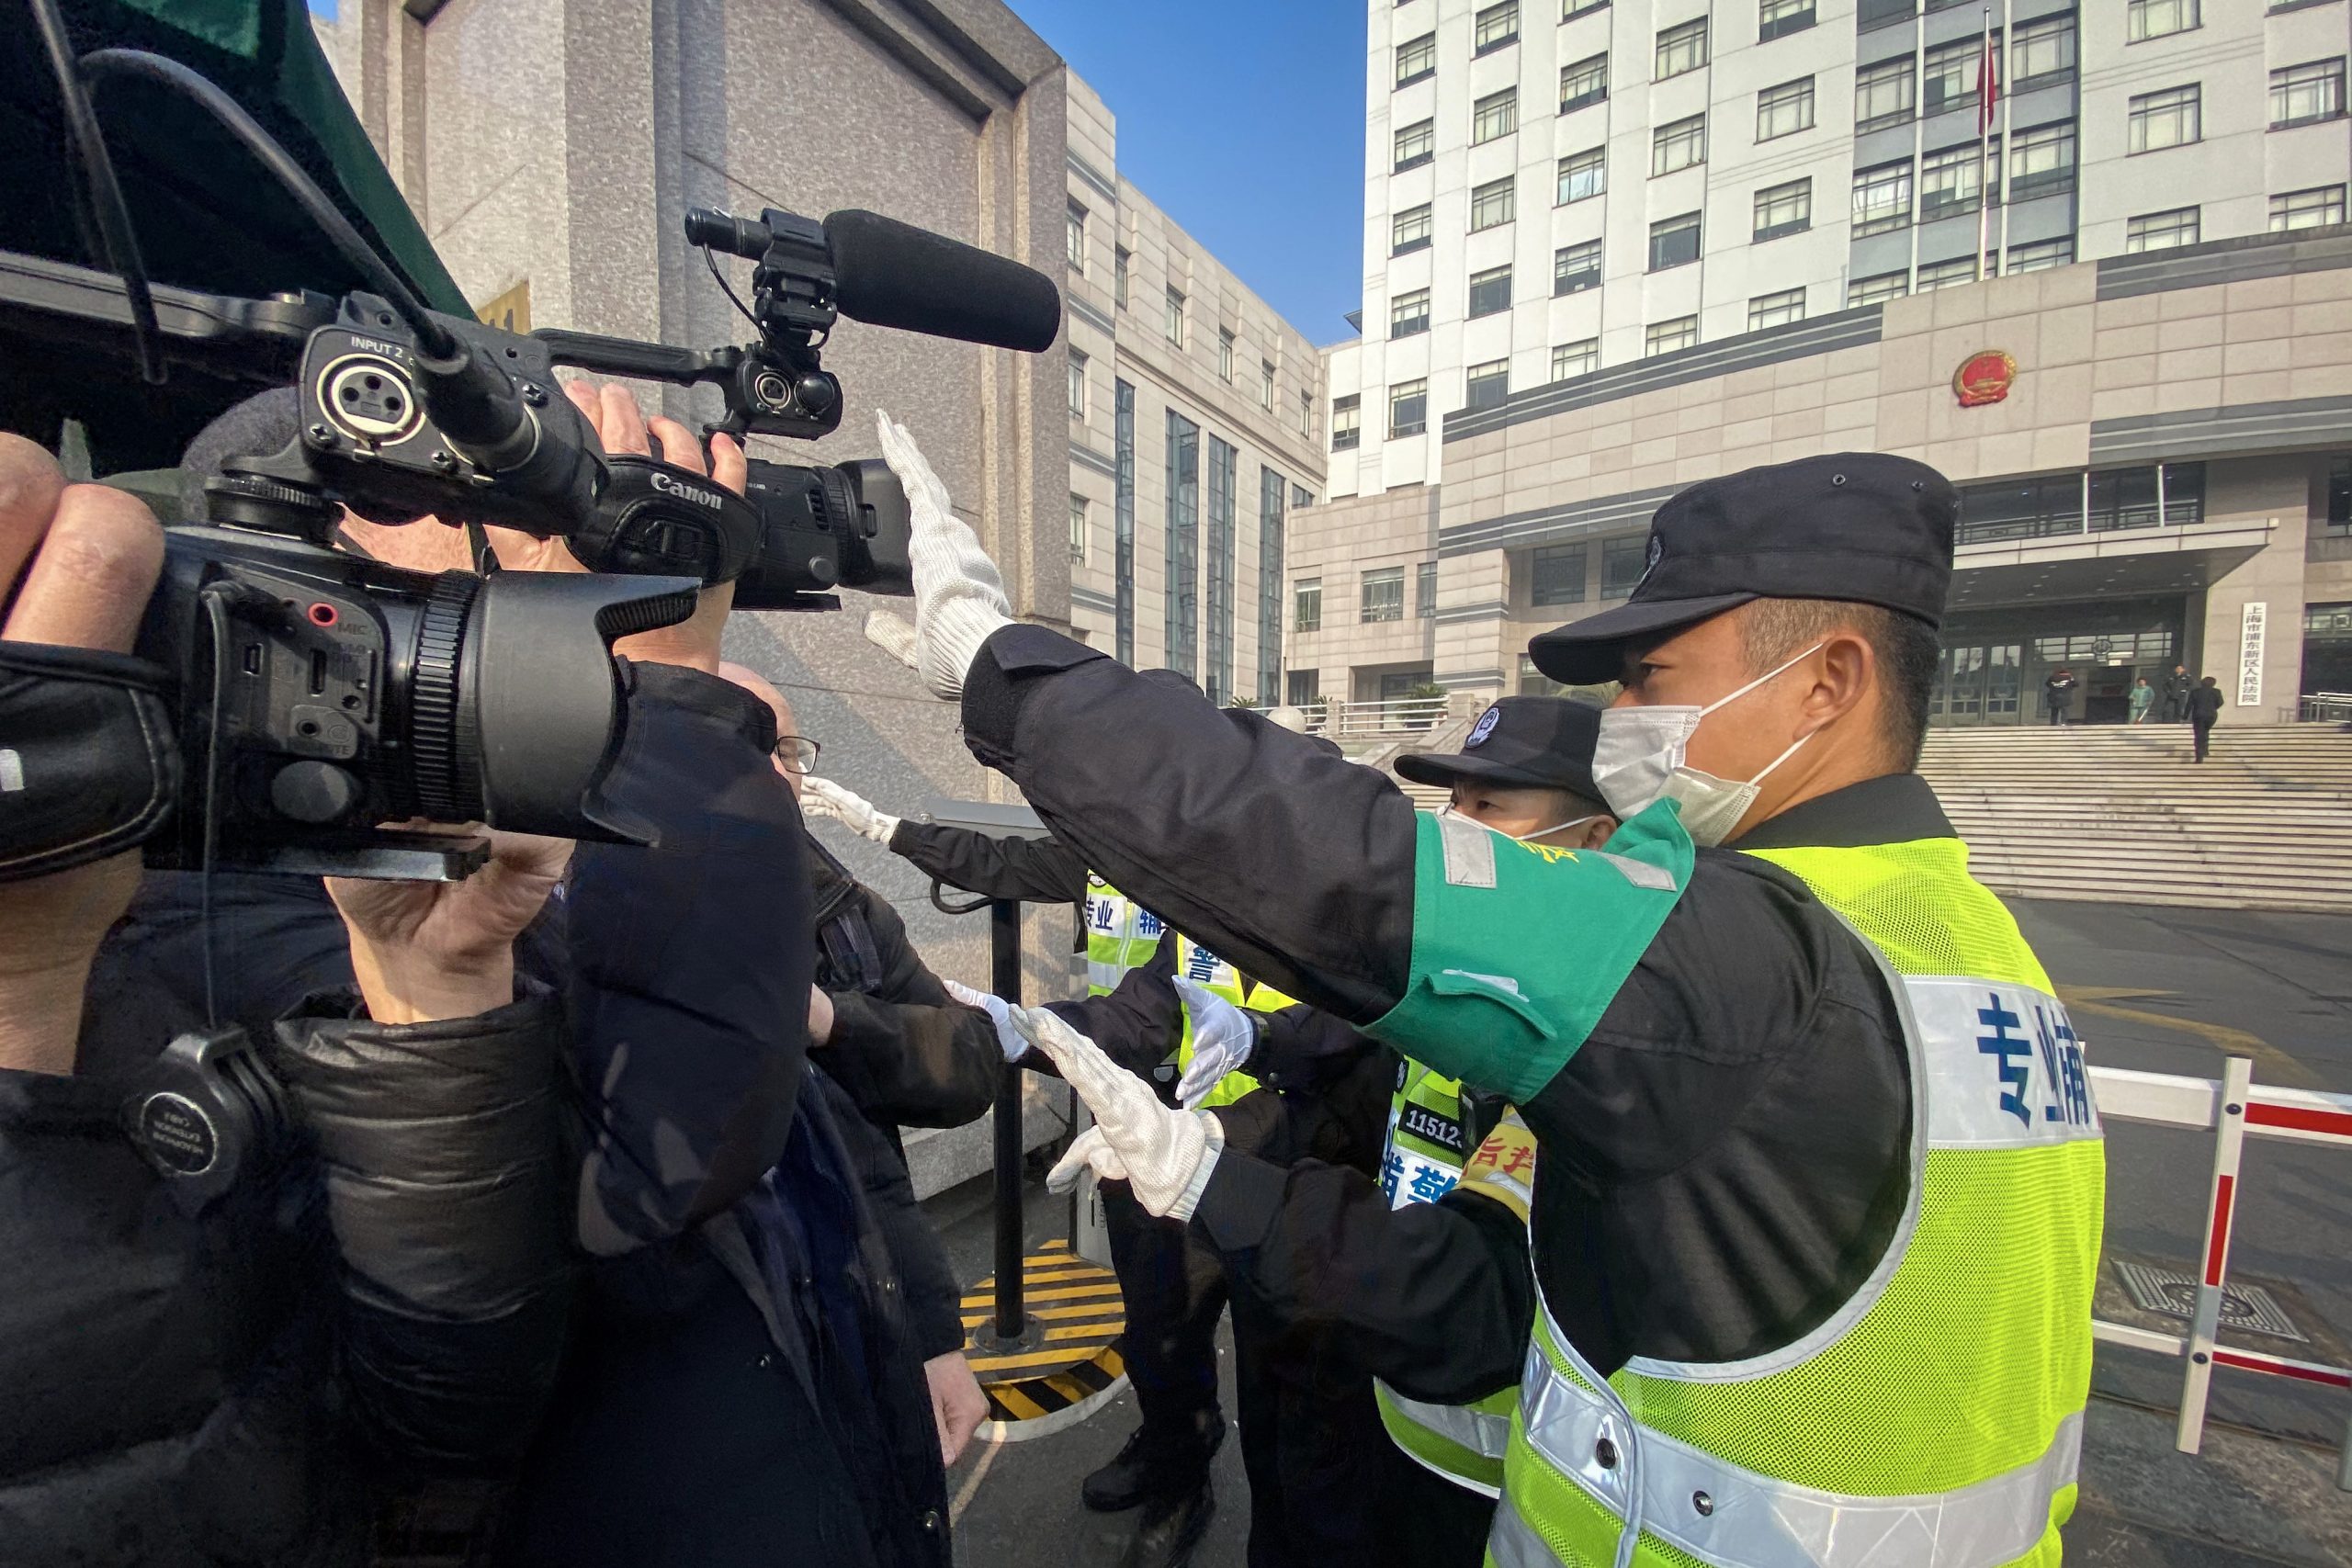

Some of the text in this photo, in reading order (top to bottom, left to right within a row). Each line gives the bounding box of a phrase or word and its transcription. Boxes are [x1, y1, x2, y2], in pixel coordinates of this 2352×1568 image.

[351, 335, 403, 358] INPUT 2
[650, 472, 722, 511] Canon
[2242, 606, 2262, 702] 上海市浦东新区人民法院
